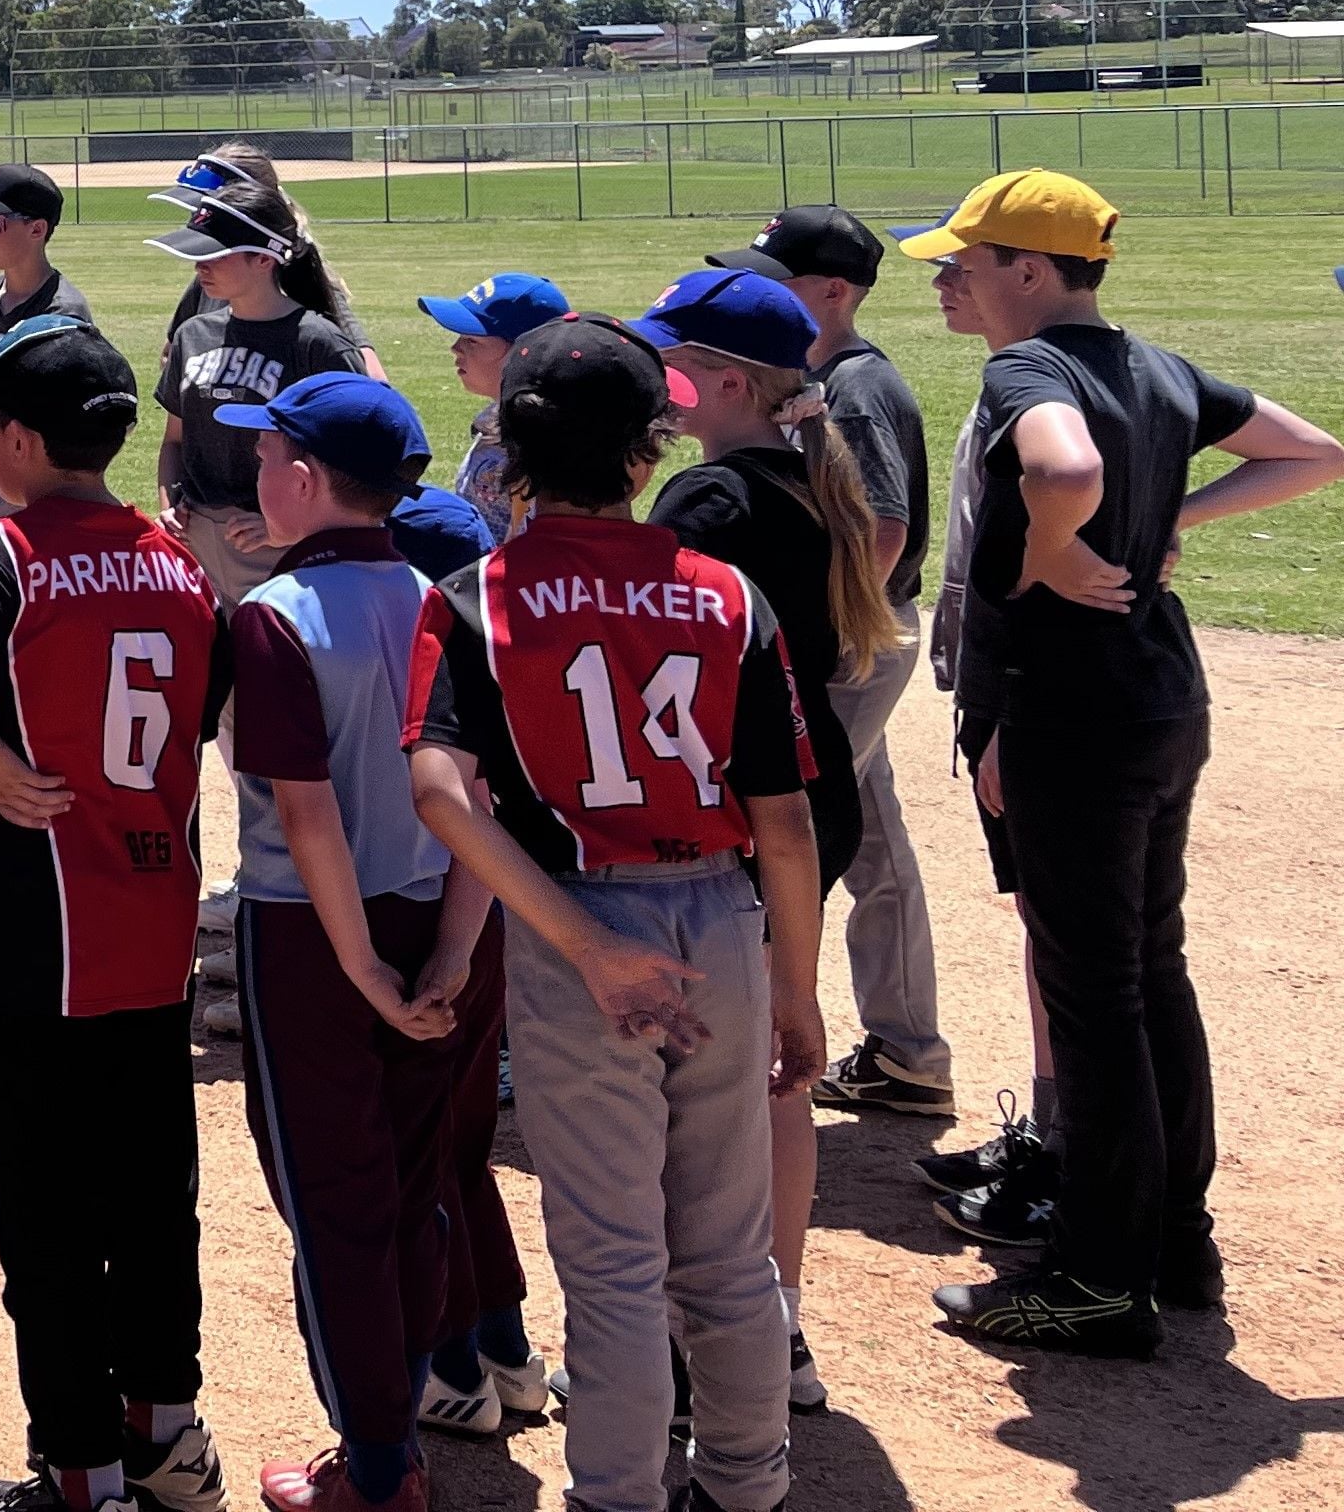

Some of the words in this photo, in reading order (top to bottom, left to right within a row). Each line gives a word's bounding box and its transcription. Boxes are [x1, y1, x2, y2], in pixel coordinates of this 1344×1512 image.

[518, 575, 729, 627] WALKER
[103, 630, 174, 791] 6
[564, 643, 722, 808] 14
